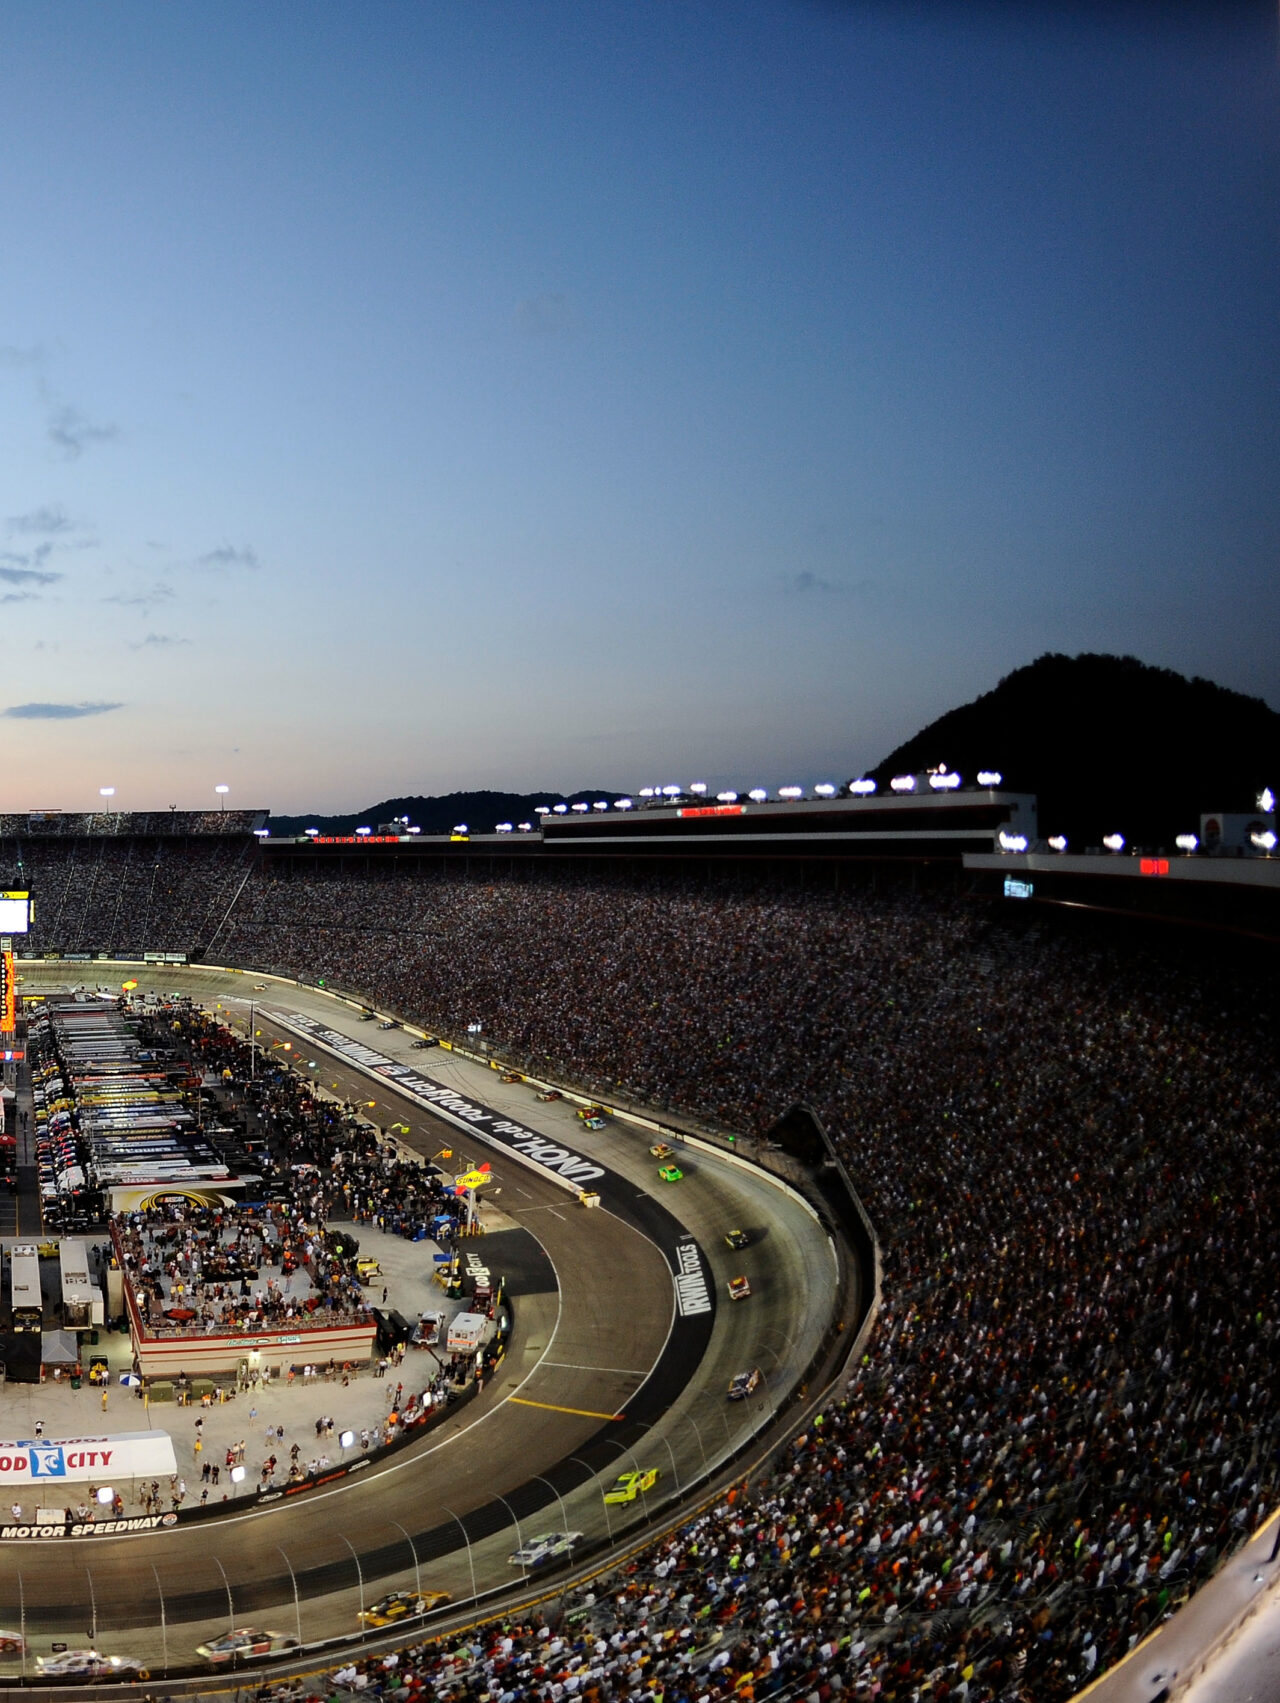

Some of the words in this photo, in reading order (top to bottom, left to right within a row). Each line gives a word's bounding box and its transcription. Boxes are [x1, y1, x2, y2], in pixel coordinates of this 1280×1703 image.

[395, 1076, 437, 1092] CITY
[440, 1099, 493, 1122] FOOD
[491, 1121, 605, 1182] UNOH.edu
[456, 1174, 491, 1185] SUNOCO
[680, 1244, 702, 1273] TOOLS
[678, 1271, 712, 1316] IRWIN
[66, 1451, 113, 1468] CITY
[1, 1526, 66, 1539] MOTOR
[71, 1515, 163, 1536] SPEEDWAY
